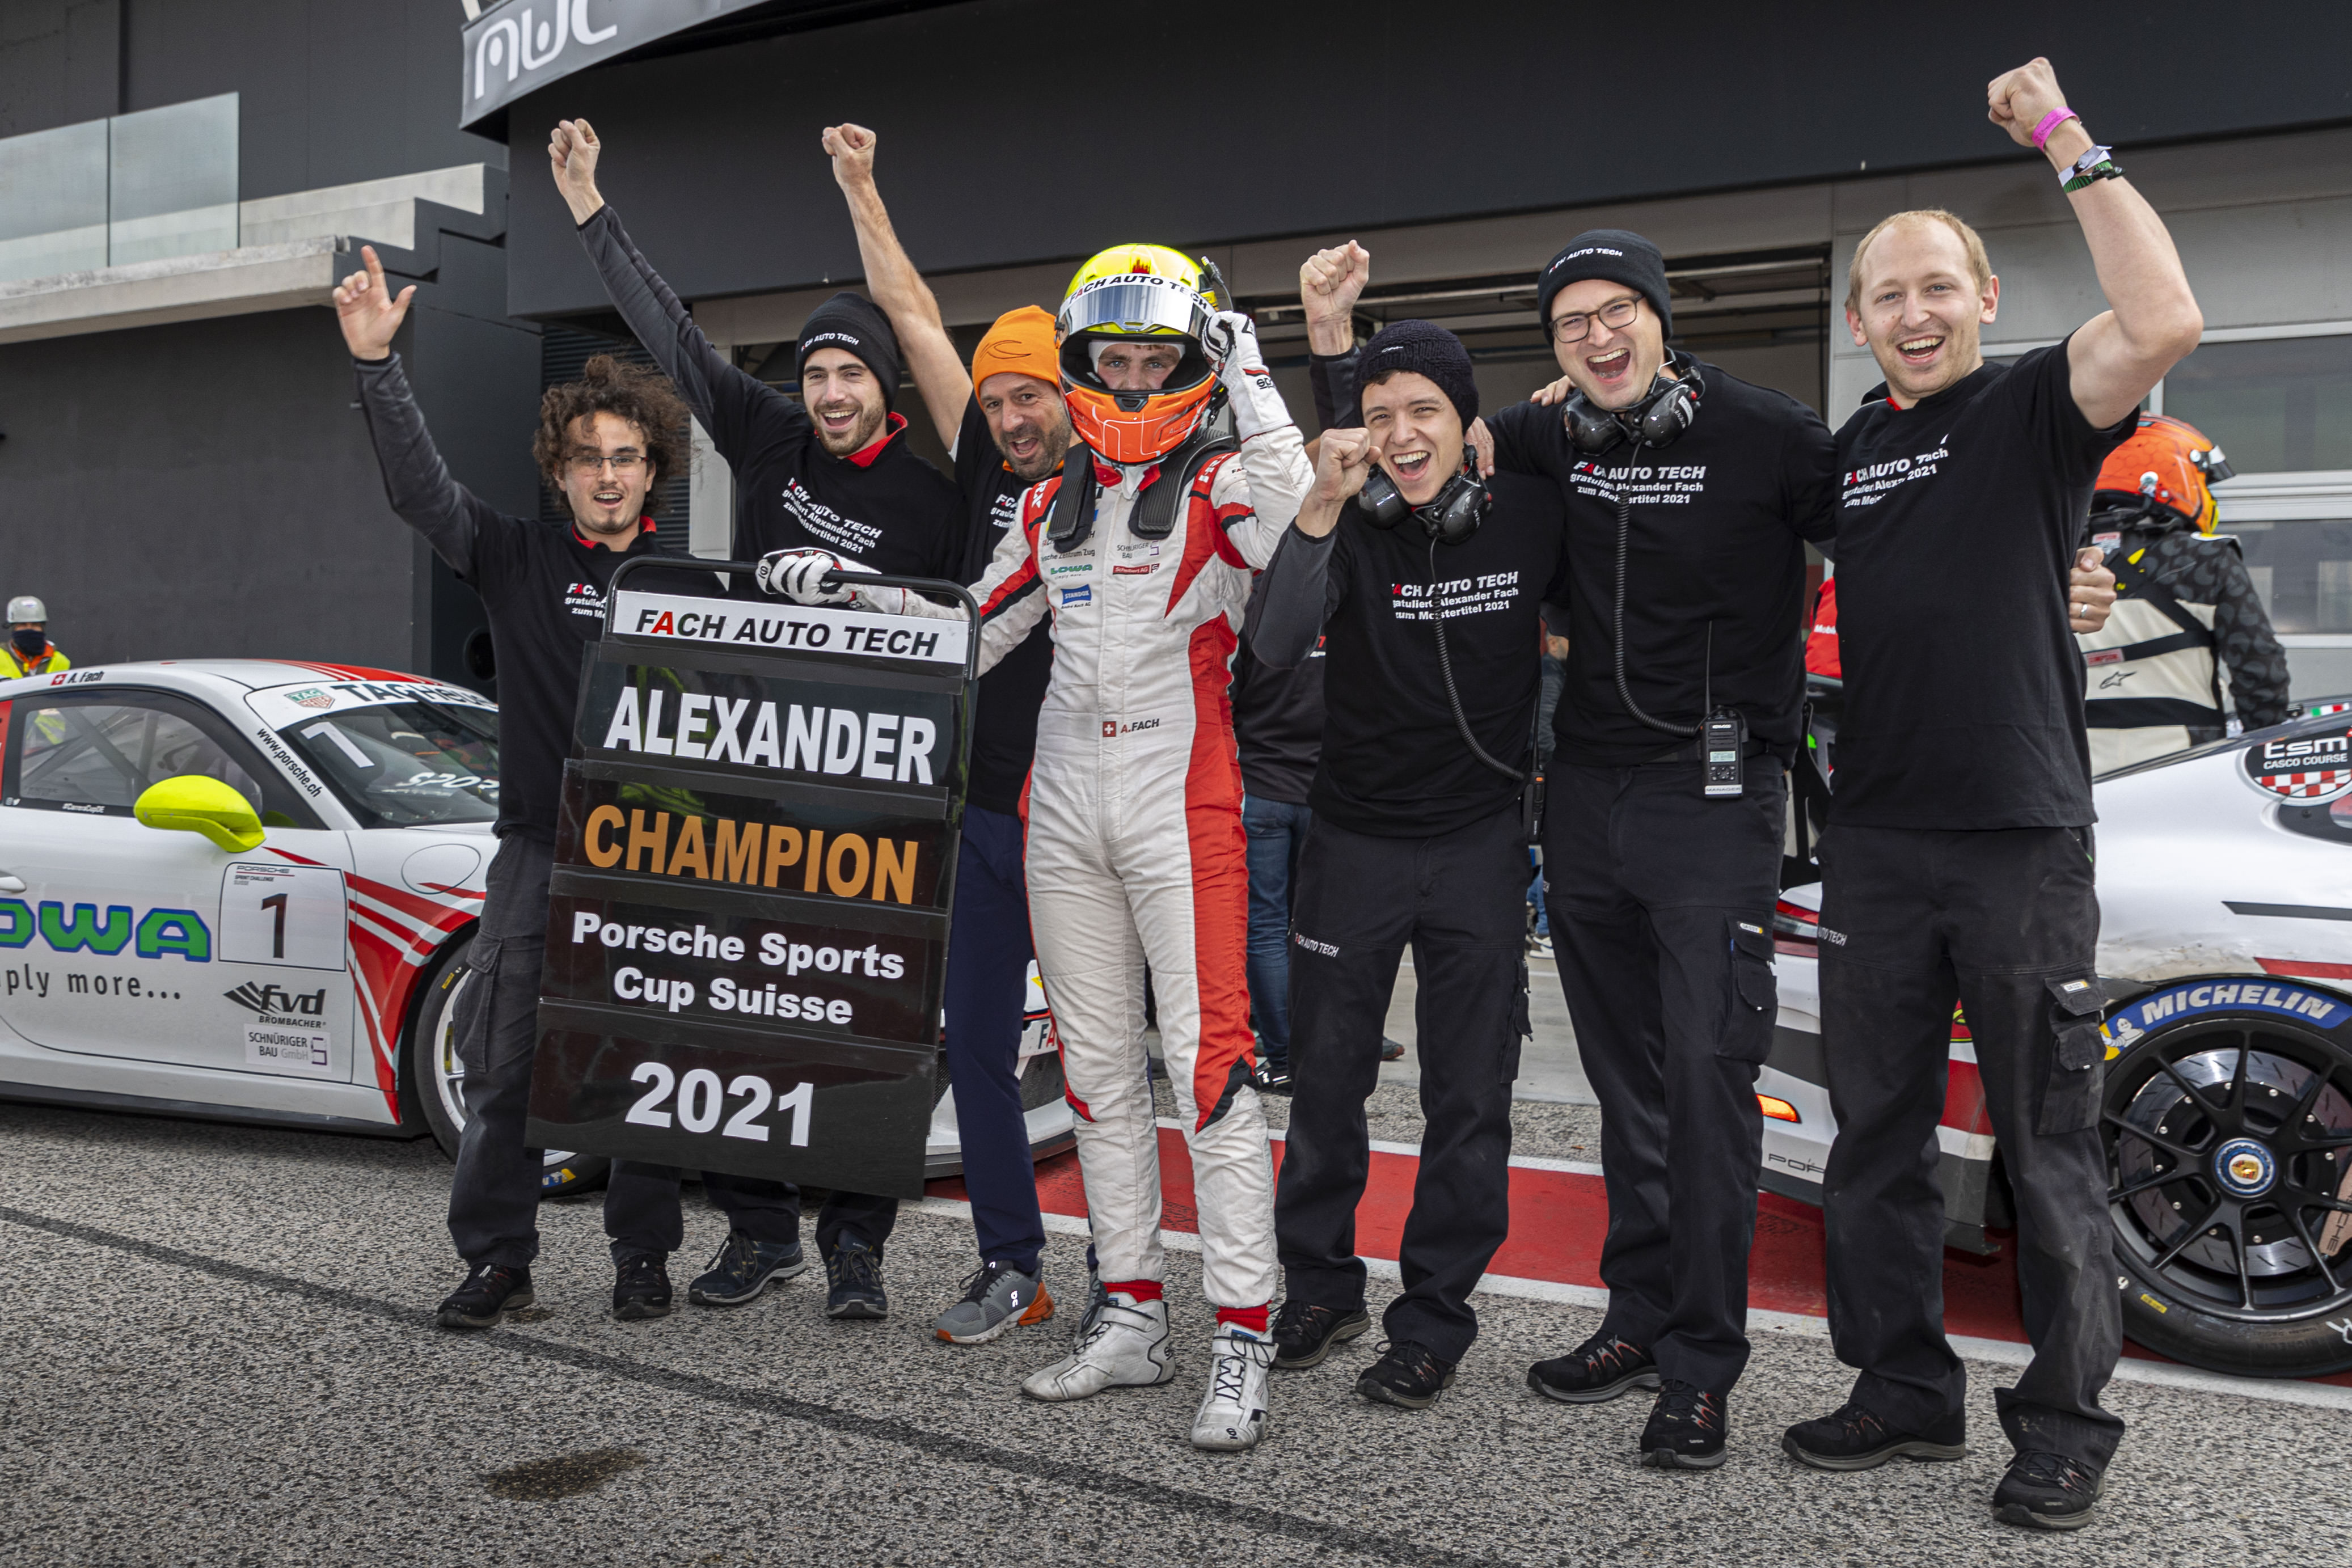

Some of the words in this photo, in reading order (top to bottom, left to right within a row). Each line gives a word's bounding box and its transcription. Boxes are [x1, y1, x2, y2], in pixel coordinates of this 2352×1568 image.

[1566, 248, 1594, 260] AUTO
[1595, 248, 1623, 257] TECH
[1069, 278, 1107, 305] FACH
[1109, 276, 1163, 285] AUTO
[1169, 281, 1207, 310] TECH
[814, 333, 835, 343] AUTO
[837, 333, 859, 345] TECH
[1608, 467, 1653, 480] AUTO
[1657, 466, 1707, 479] TECH
[1843, 467, 1868, 486] FACH
[1869, 458, 1911, 479] AUTO
[1907, 463, 1938, 481] 2021
[1577, 485, 1597, 496] zum
[1662, 494, 1691, 504] 2021
[1674, 482, 1704, 492] Fach
[806, 502, 841, 522] AUTO
[843, 519, 883, 539] TECH
[807, 512, 853, 538] Alexander
[852, 533, 876, 548] Fach
[839, 539, 864, 554] 2021
[1084, 548, 1096, 557] Zug
[1050, 564, 1093, 575] LOWA
[1392, 584, 1422, 597] ACH
[1476, 570, 1519, 589] TECH
[1494, 586, 1519, 598] Fach
[1064, 590, 1090, 599] STANDOX
[571, 607, 593, 617] zum
[1484, 600, 1510, 611] 2021
[635, 608, 727, 640] FACH
[733, 618, 832, 648] AUTO
[844, 625, 939, 657] TECH
[292, 688, 326, 701] TAG
[299, 695, 333, 708] HEUER
[301, 721, 375, 768] 1
[603, 686, 937, 785] ALEXANDER
[257, 728, 323, 798] www.porsche.ch
[2263, 758, 2301, 770] CASCO
[2303, 753, 2348, 766] COURSE
[584, 804, 919, 905] CHAMPION
[237, 865, 290, 874] PORSCHE
[261, 893, 288, 959] 1
[572, 911, 745, 962] Porsche
[758, 932, 905, 980] Sports
[1829, 930, 1848, 946] TECH
[1304, 938, 1319, 952] AUTO
[1318, 942, 1340, 958] TECH
[67, 973, 181, 1000] more...
[613, 966, 695, 1013] Cup
[708, 977, 853, 1025] Suisse
[259, 984, 327, 1016] fvd
[2141, 984, 2336, 1026] MICHELIN
[248, 1032, 308, 1048] SCHNÜRIGER
[1038, 1023, 1057, 1050] FA
[259, 1046, 278, 1058] BAU
[281, 1049, 309, 1061] GmbH
[624, 1061, 815, 1148] 2021
[1768, 1153, 1826, 1174] POR
